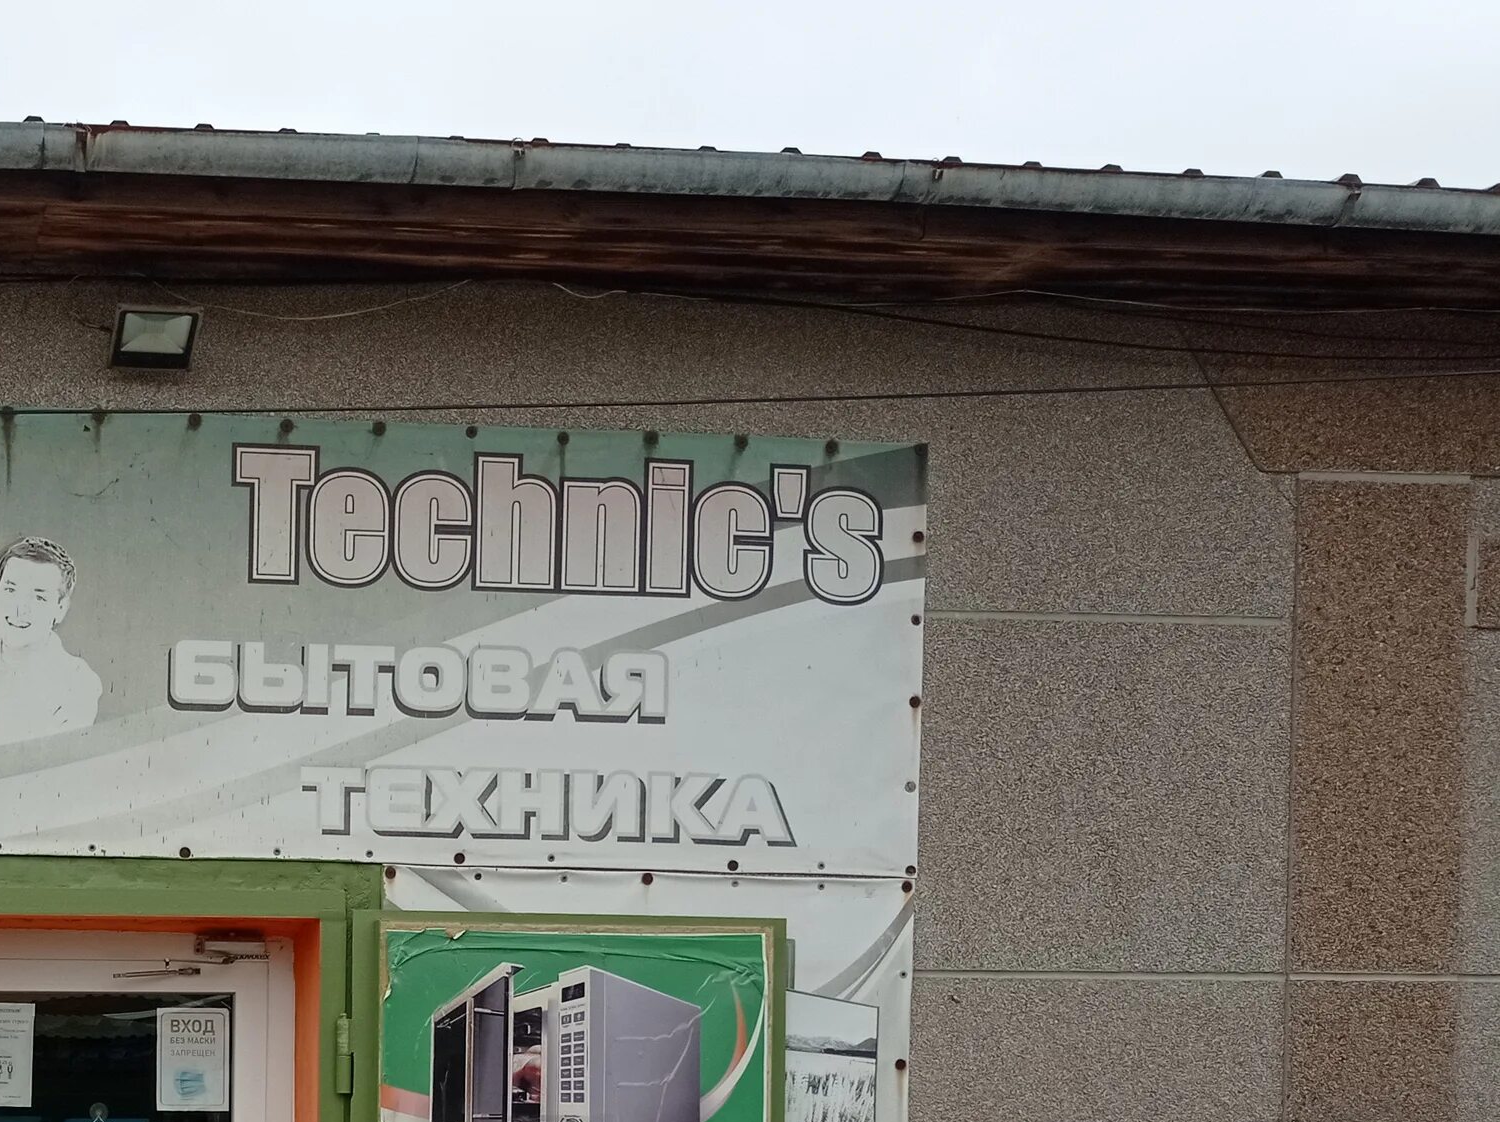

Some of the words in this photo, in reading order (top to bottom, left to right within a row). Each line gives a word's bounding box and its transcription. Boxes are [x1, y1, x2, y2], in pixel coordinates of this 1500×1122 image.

[232, 443, 883, 605] Technic's
[167, 639, 670, 725] БЫТОВАЯ
[301, 766, 797, 847] ТЕХНИКА
[170, 1019, 215, 1036] ВХОД
[170, 1036, 185, 1044] БЕЗ
[187, 1036, 216, 1045] МАСКИ
[170, 1049, 216, 1058] ЗАПРЕЩЕН
